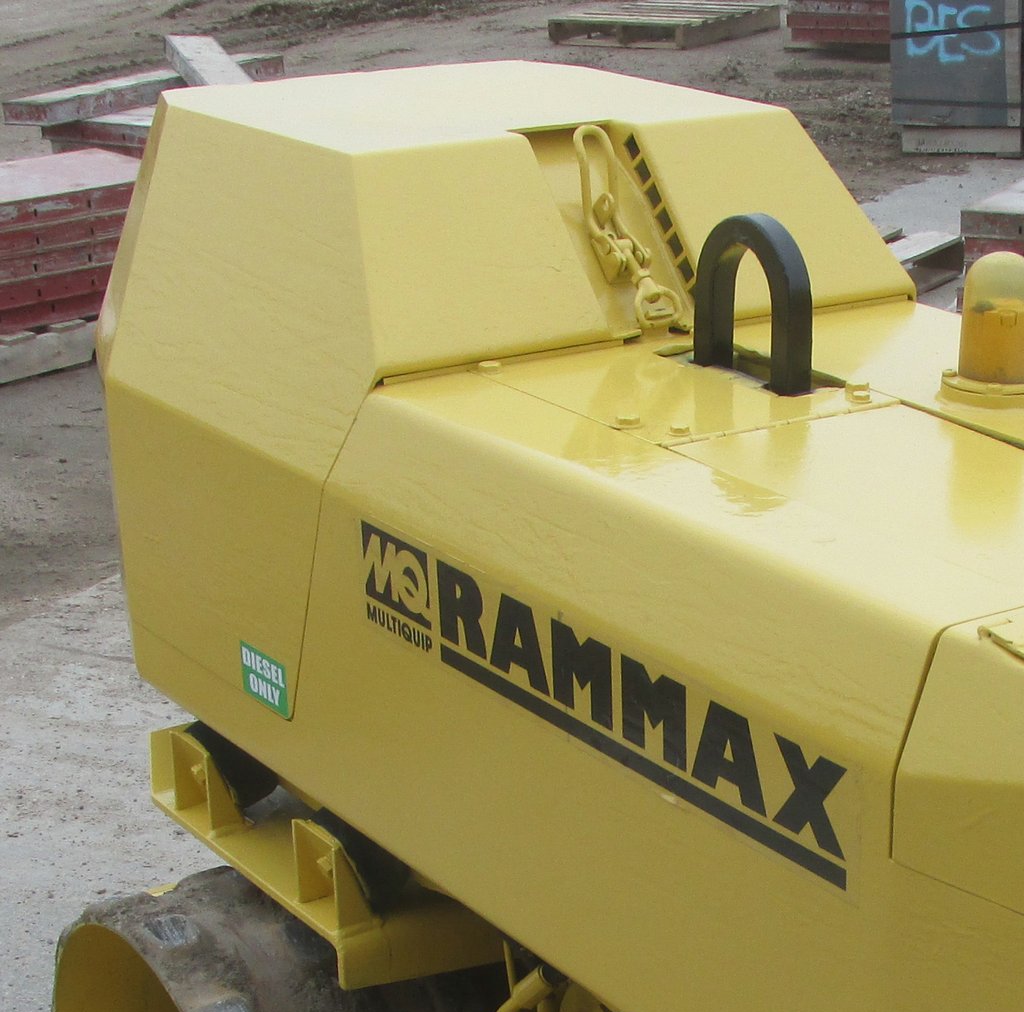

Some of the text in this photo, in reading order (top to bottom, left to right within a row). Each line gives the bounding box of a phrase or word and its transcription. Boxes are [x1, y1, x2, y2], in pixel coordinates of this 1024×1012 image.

[366, 602, 433, 653] MULTIQUIP
[241, 645, 286, 689] DIESEL
[249, 672, 280, 707] ONLY
[437, 559, 847, 861] RAMMAX
